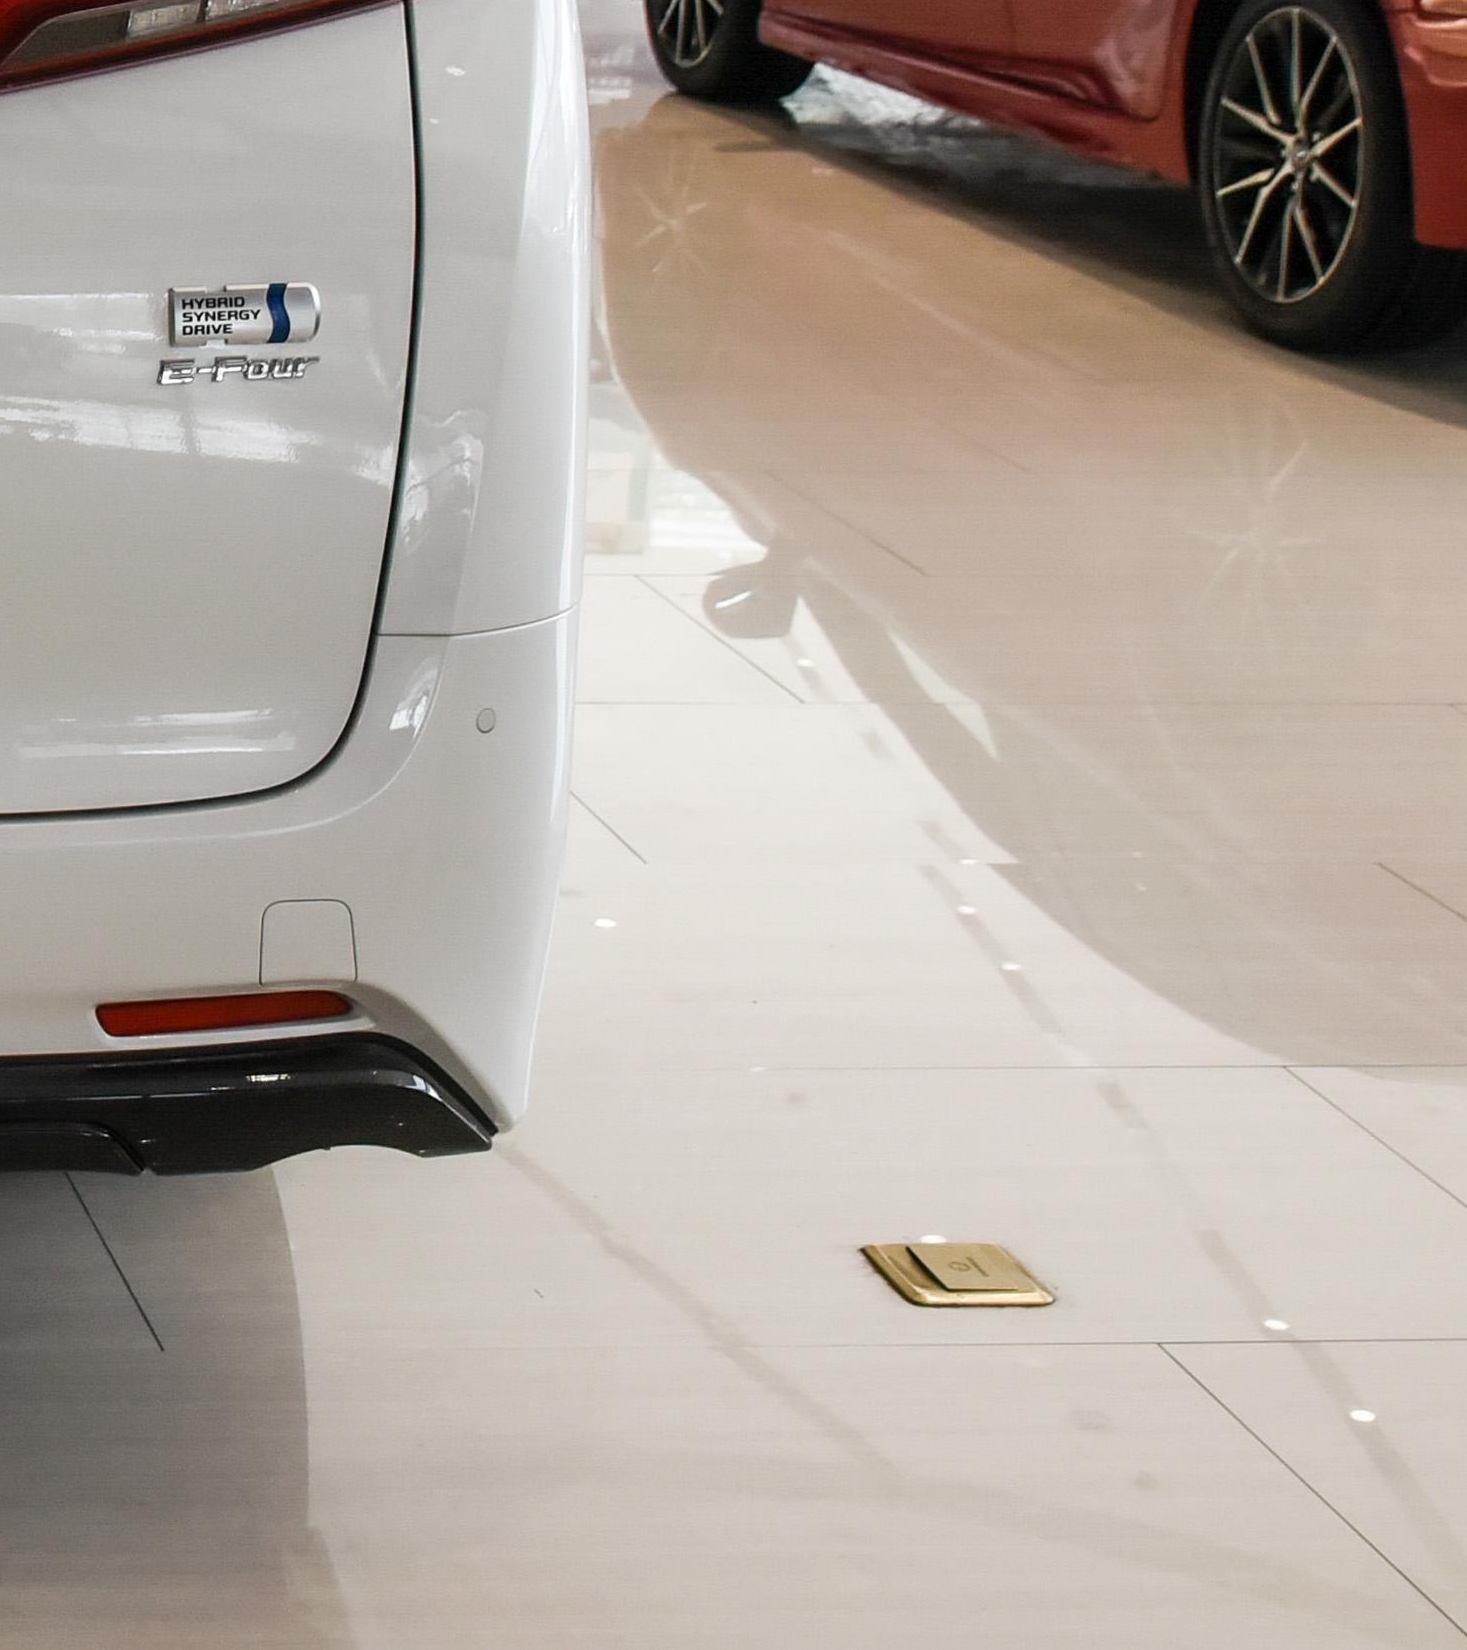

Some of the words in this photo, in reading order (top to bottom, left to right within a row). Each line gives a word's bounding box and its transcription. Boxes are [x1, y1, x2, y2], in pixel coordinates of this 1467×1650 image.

[181, 296, 245, 310] HYBRID
[182, 309, 261, 323] SYNERGY
[182, 323, 233, 336] DRIVE
[157, 355, 320, 386] E-Four
